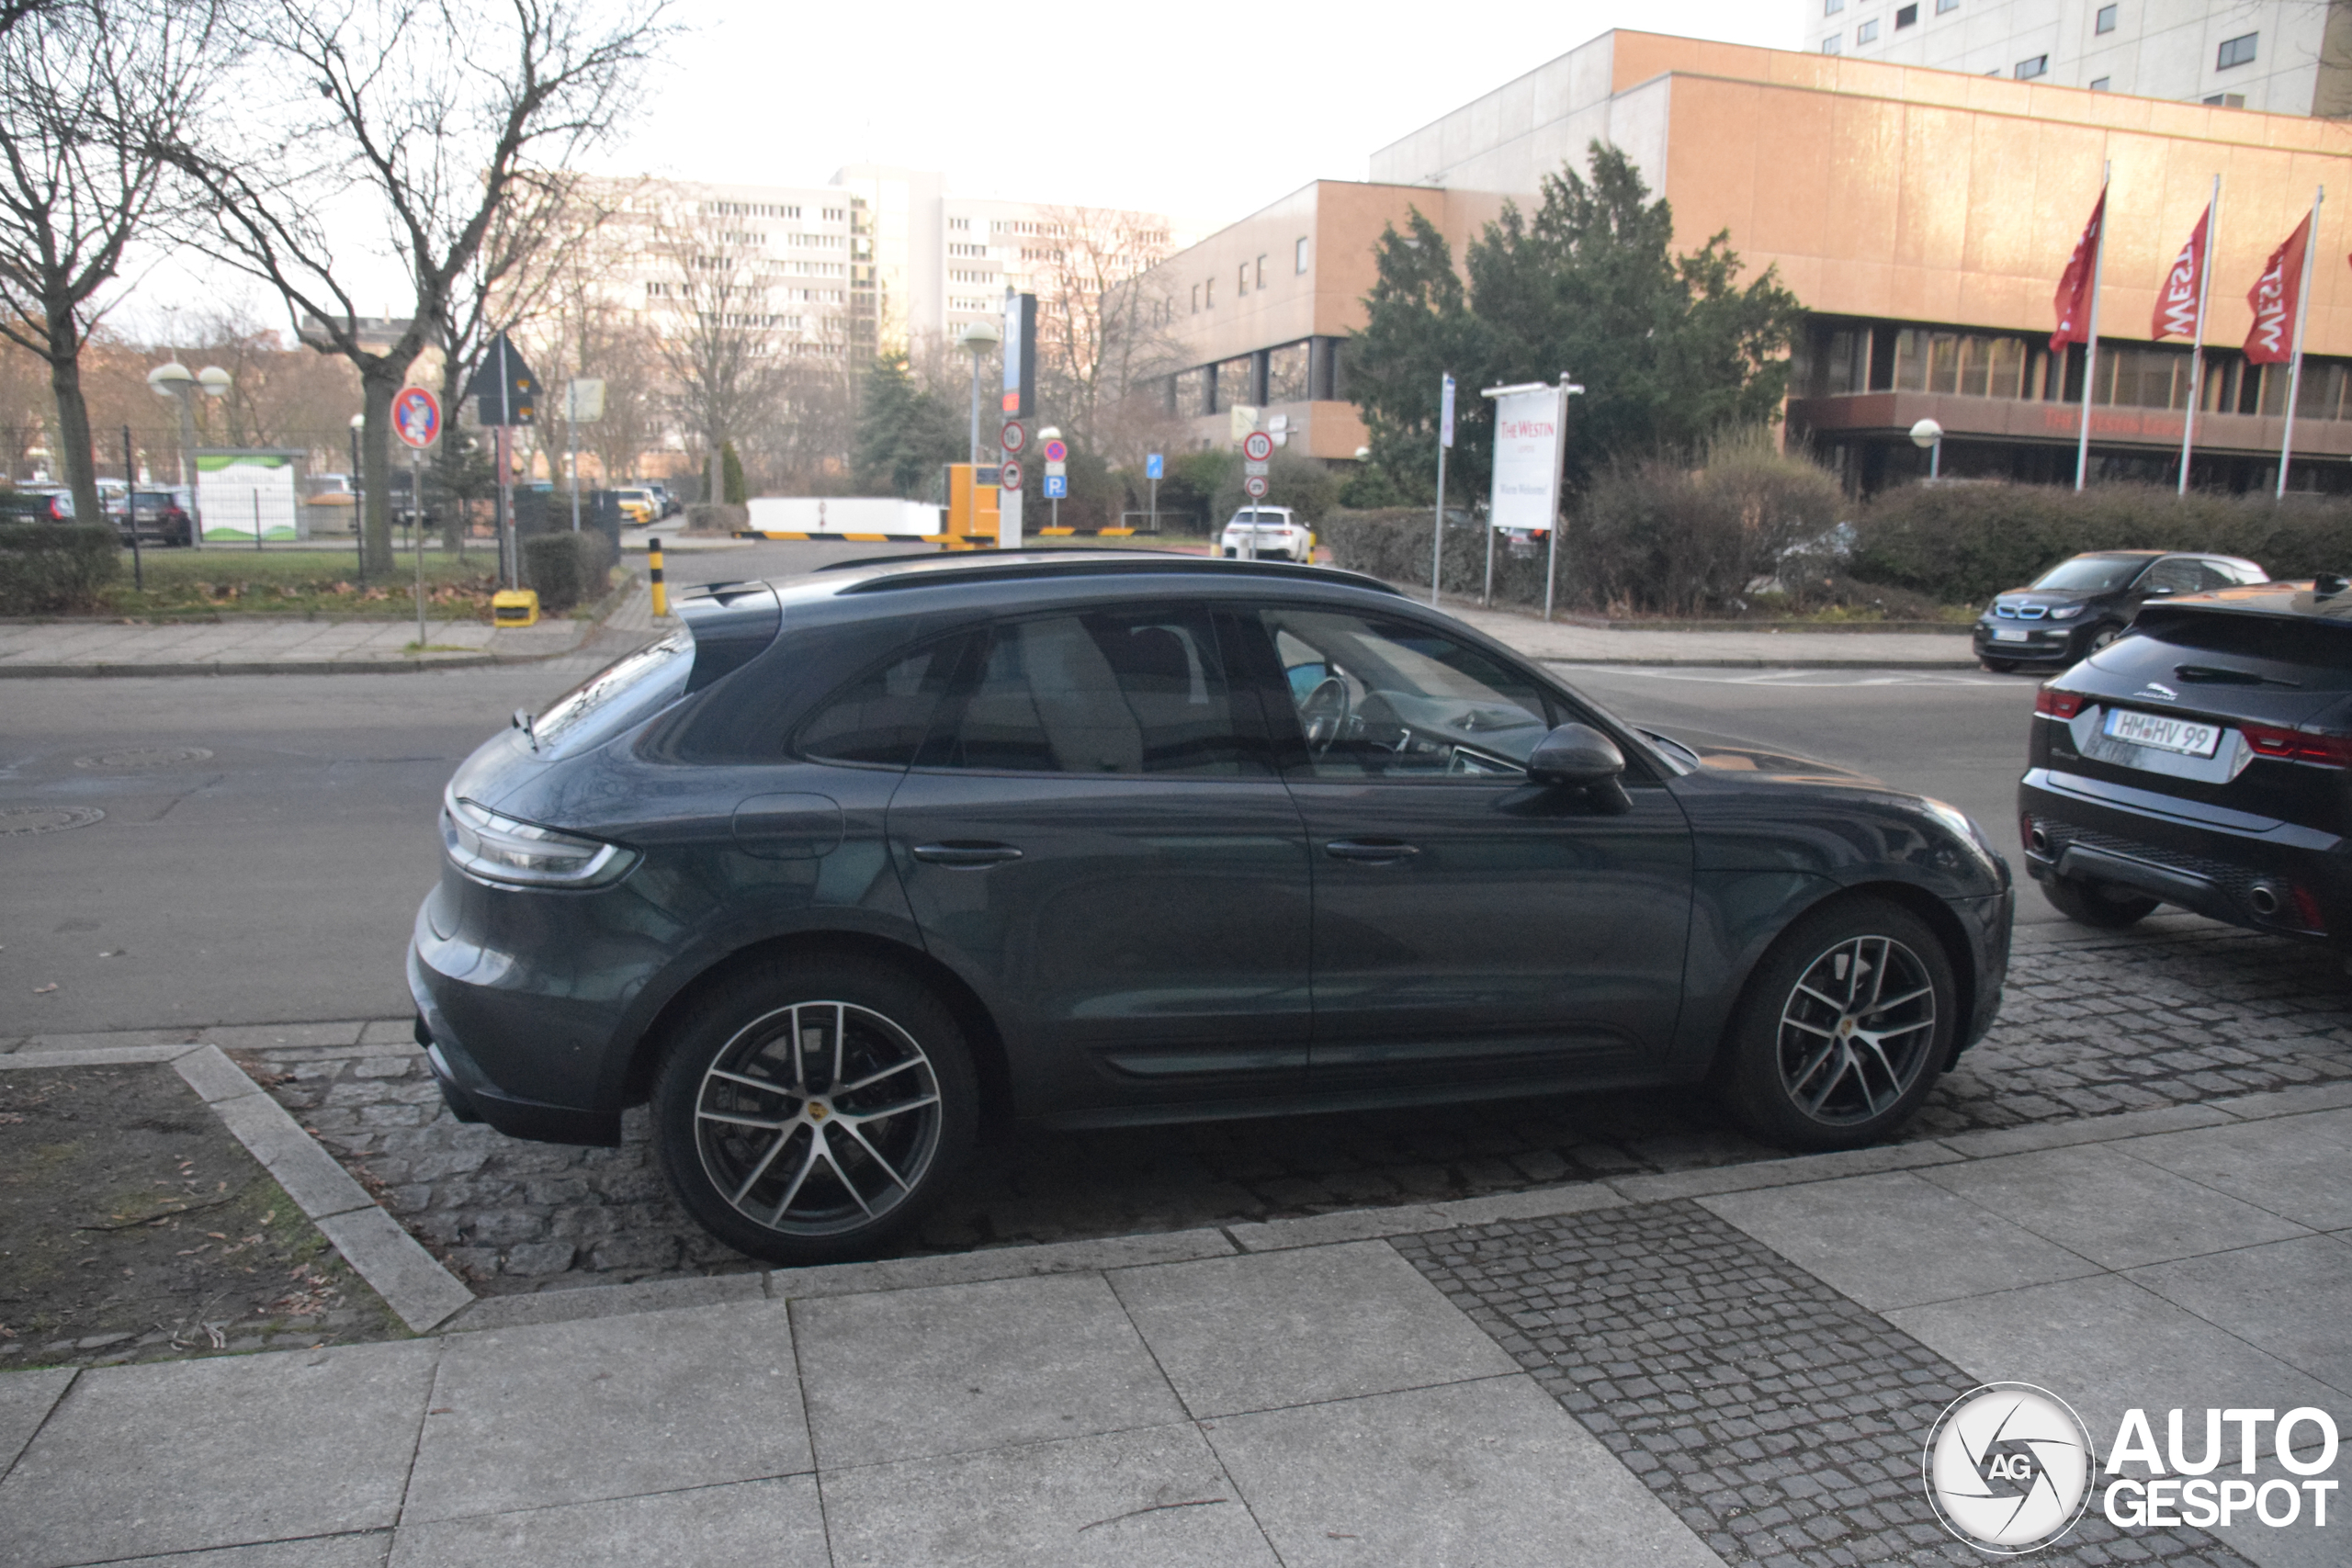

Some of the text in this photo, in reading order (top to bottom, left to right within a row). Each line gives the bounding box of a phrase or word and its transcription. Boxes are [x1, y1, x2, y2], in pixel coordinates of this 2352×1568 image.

[1501, 421, 1554, 438] THE WESTIN
[1251, 440, 1267, 454] 10
[1048, 478, 1062, 495] P
[2132, 691, 2177, 702] JAGUAR
[2182, 726, 2209, 750] 99
